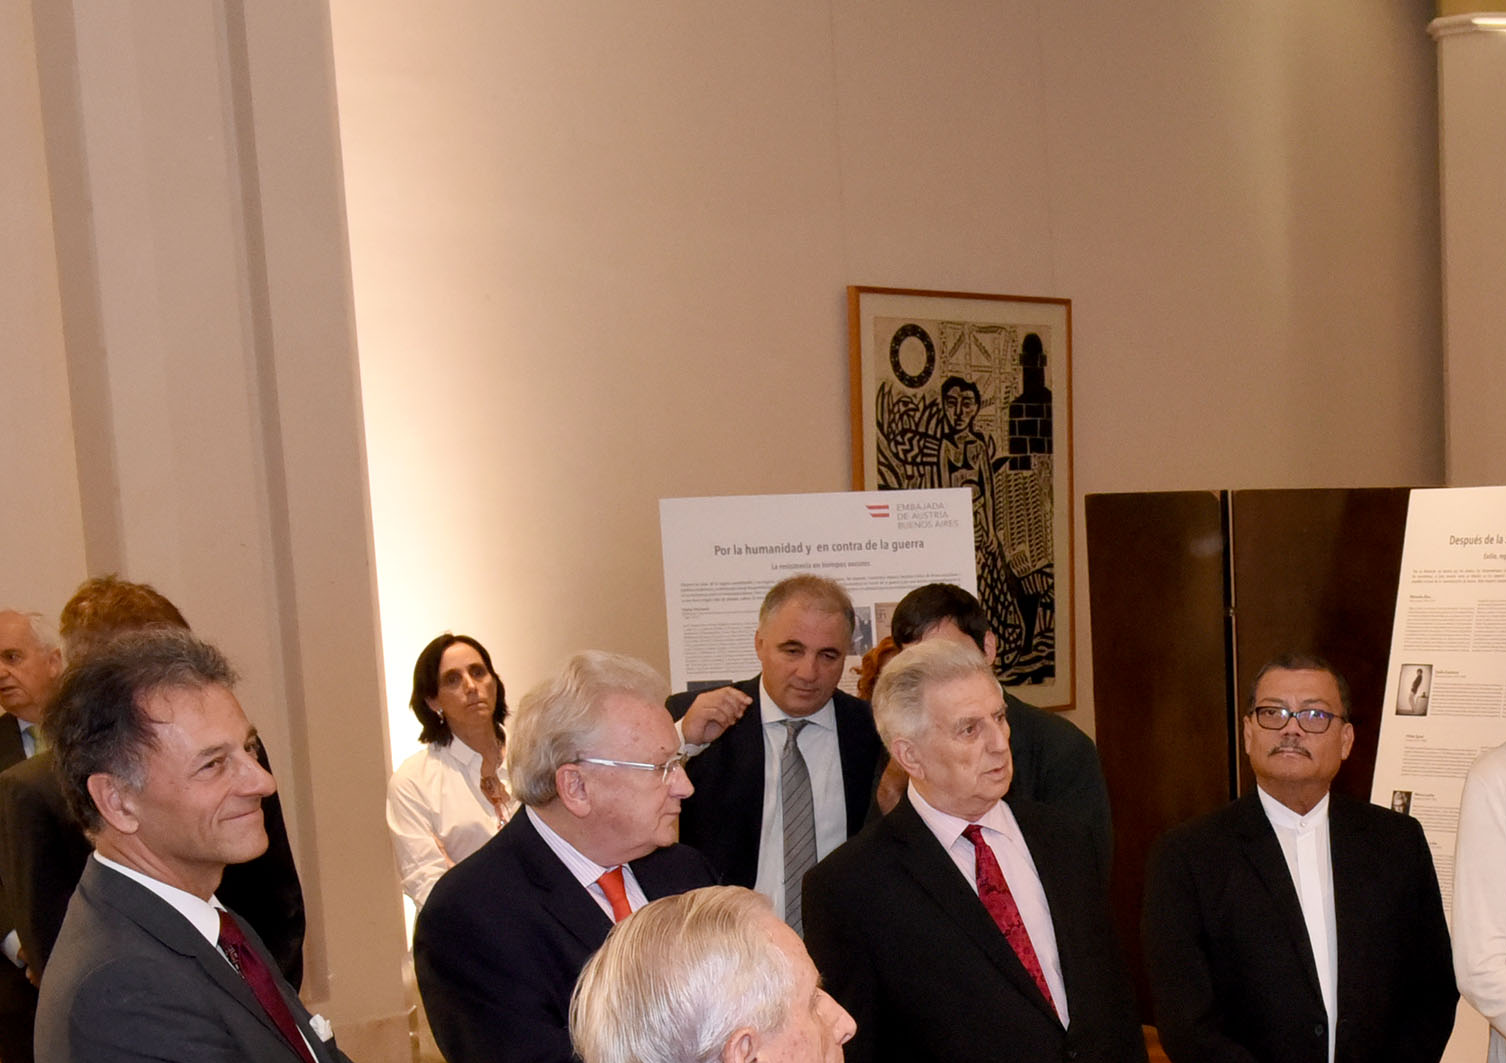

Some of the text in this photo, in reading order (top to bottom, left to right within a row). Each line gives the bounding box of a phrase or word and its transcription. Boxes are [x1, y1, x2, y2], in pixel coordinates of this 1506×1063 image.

[896, 502, 945, 511] EMBAJADA
[896, 510, 949, 520] DE AUSTRIA
[897, 519, 959, 530] BUENOS AIRES
[1449, 533, 1482, 547] Después
[1484, 534, 1495, 545] de
[1496, 533, 1503, 544] la
[714, 539, 924, 556] Por la humanidad y en contra de la guerra
